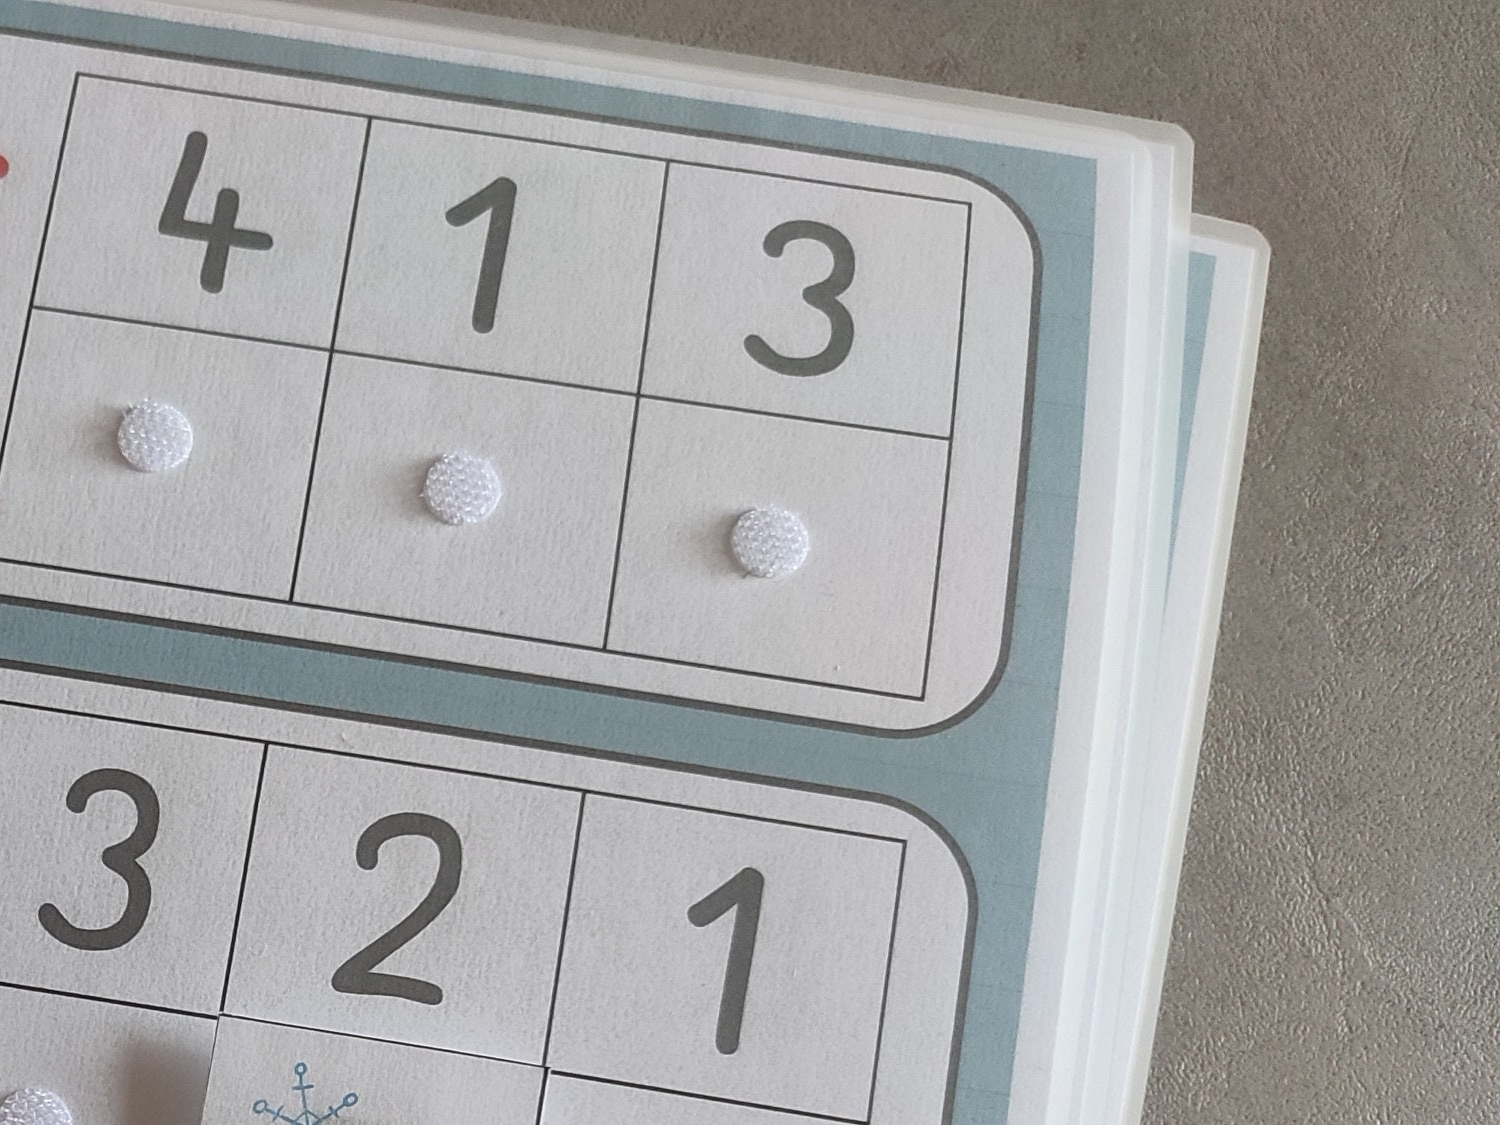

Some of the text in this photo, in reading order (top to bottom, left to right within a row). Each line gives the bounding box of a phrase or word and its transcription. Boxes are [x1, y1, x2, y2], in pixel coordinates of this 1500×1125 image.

[158, 131, 856, 377] 4 1 3
[38, 768, 765, 1055] 3 2 1
